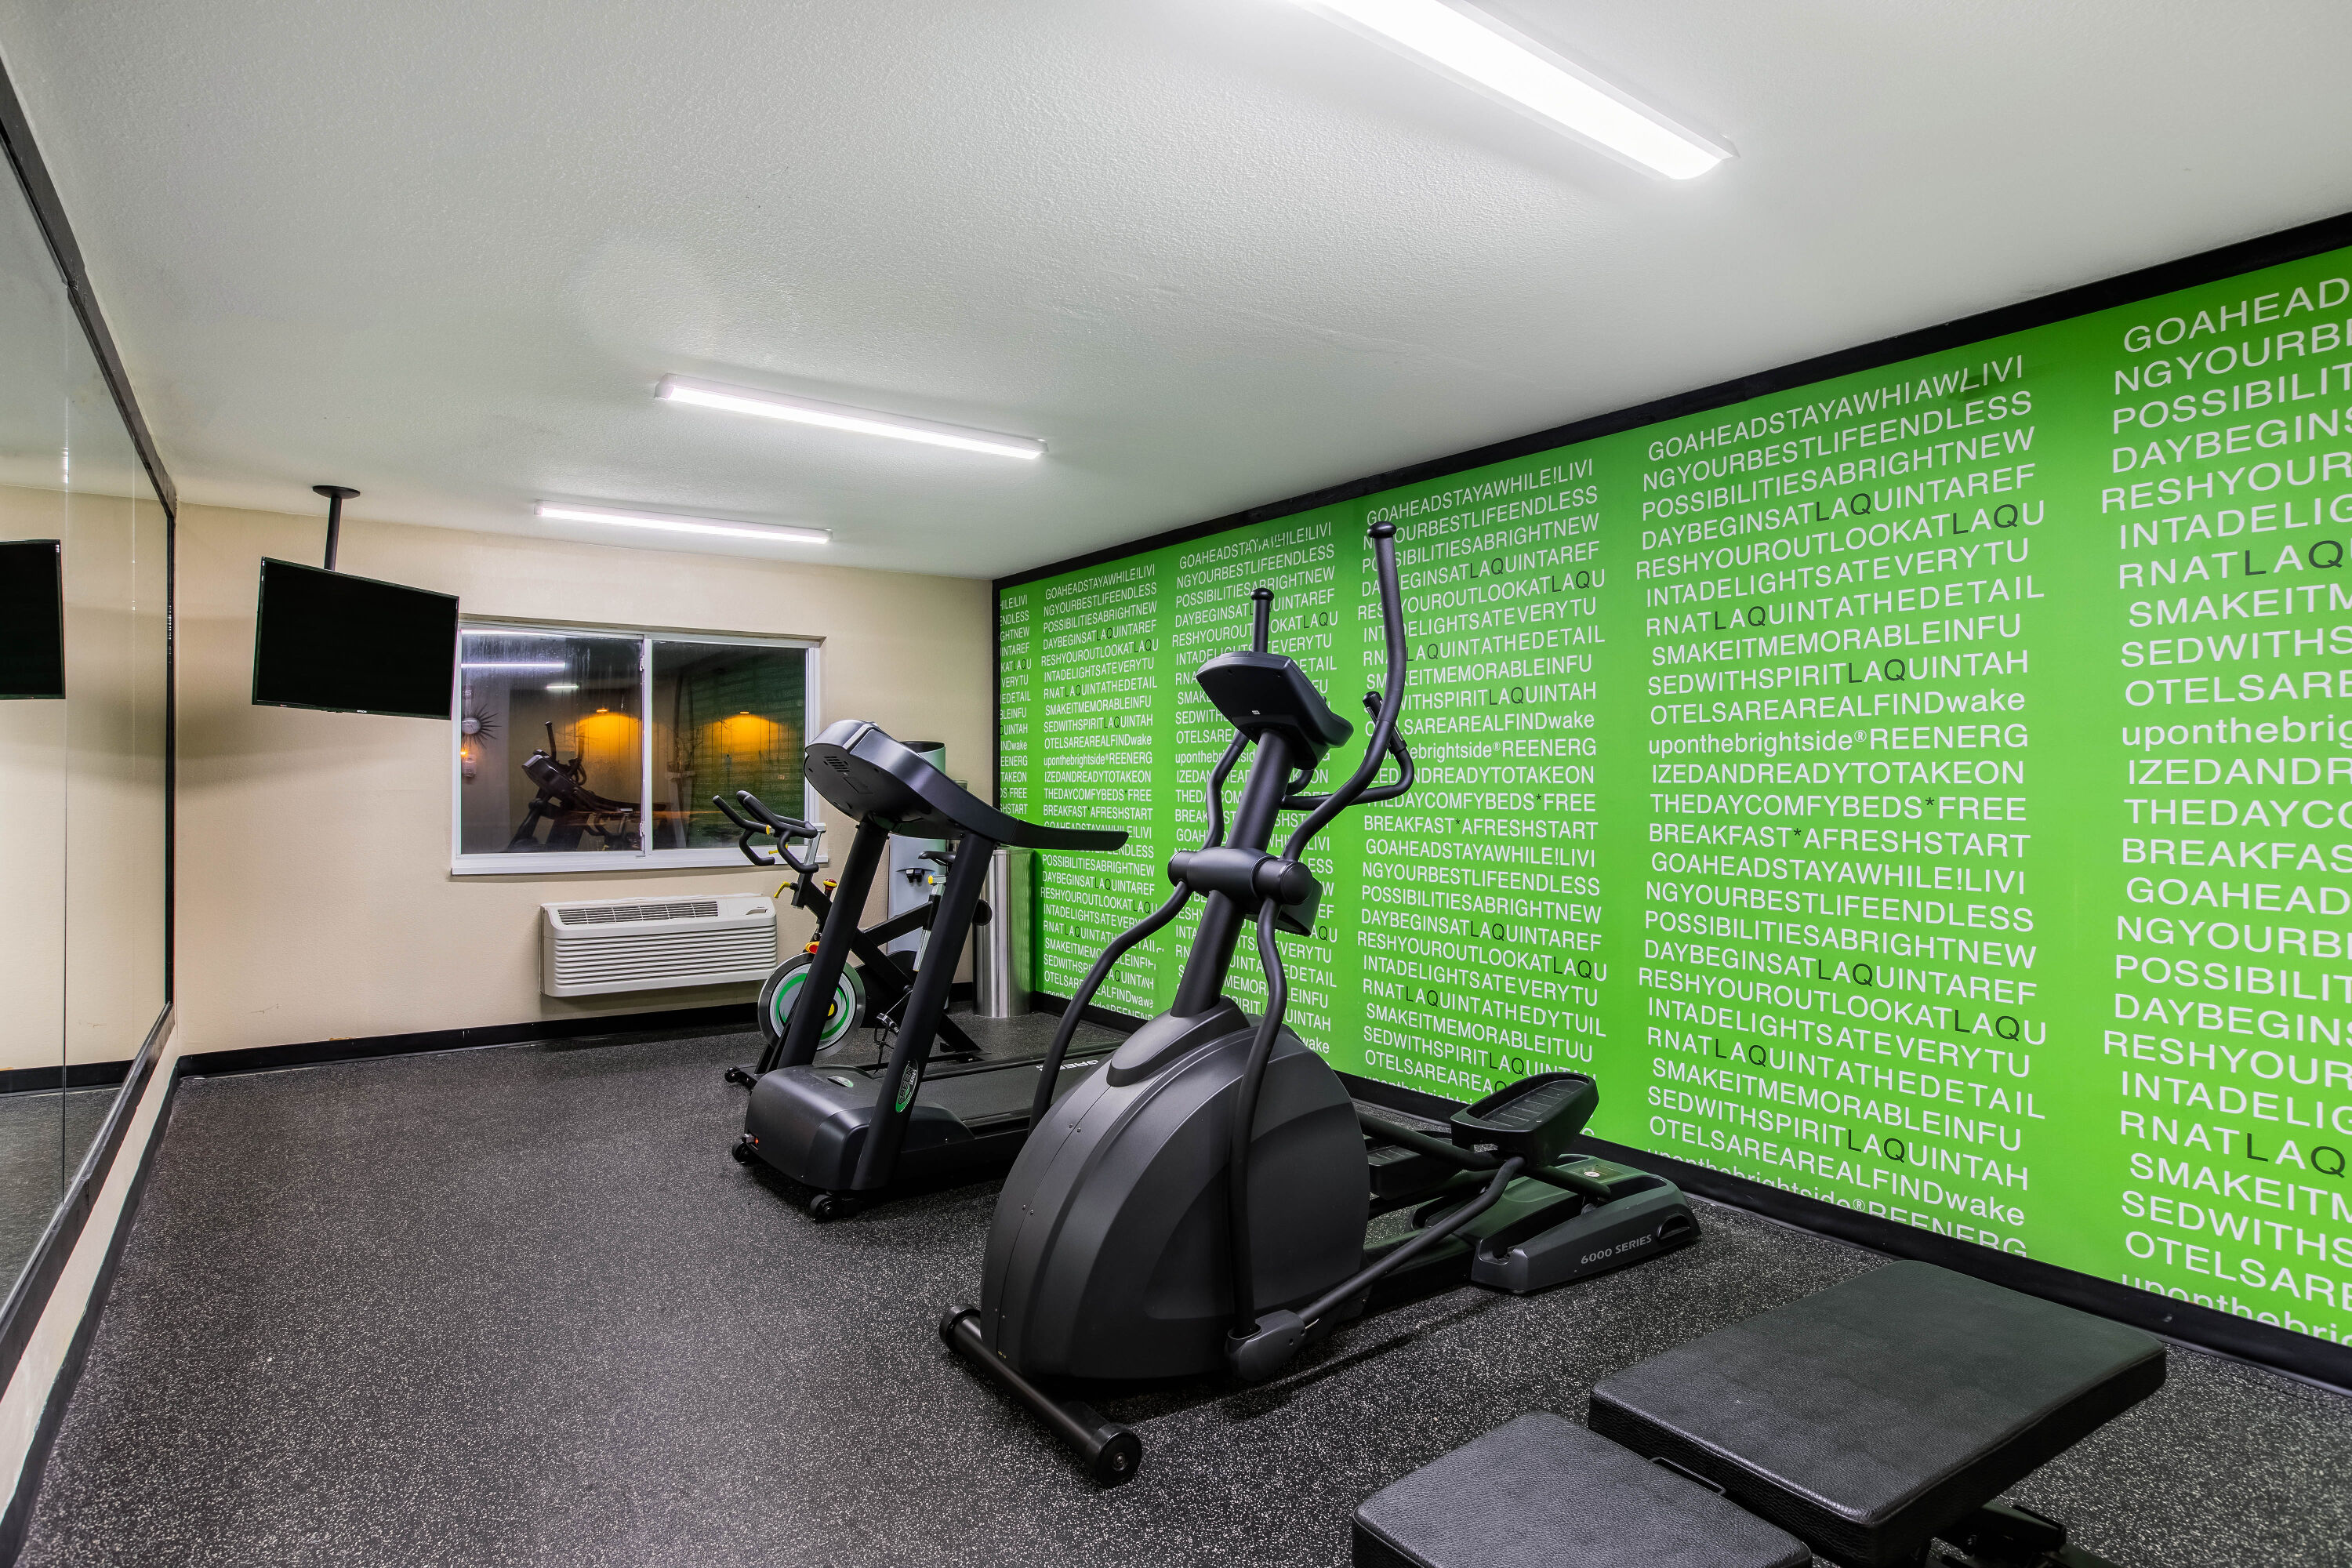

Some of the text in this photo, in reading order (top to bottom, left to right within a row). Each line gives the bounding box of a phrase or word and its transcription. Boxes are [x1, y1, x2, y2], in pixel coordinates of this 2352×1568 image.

[2125, 278, 2349, 352] GOAHEAD
[2115, 319, 2352, 395] NGYOURB
[2114, 362, 2352, 434] POSSIBILIT
[1644, 391, 2031, 492] NGYOURBESTLIFEENDLESS
[1367, 459, 1592, 527] GOAHEADSTAYAWHILE!LIVI
[1643, 426, 2034, 521] POSSIBILITIESABRIGHTNEW
[2102, 452, 2352, 514] RESHYOUR
[1363, 485, 1597, 550] NOURBESTLIFEENDLESS
[2121, 493, 2352, 550] INTADELIG
[1177, 544, 1334, 589] NGYOURBESTLIFEENDLESS
[1363, 513, 1599, 574] PSIBILITIESABRIGHTNEW
[2119, 540, 2352, 590] RNATLAQ
[1046, 564, 1154, 600] GOAHEADSTAYAWHILE!LIVI
[1363, 541, 1599, 597] DAEGINSATLAQUINTAREF
[1647, 537, 2028, 607] INTADELIGHTSATEVERYTU
[1044, 583, 1156, 616] NGYOURBESTLIFEENDLESS
[1044, 601, 1156, 633] POSSIBILITIESABRIGHTNEW
[2129, 583, 2352, 627] SMAKEITM
[1000, 642, 1029, 657] INTAREF
[1653, 613, 2020, 666] SMAKEITMEMORABLEINFU
[2121, 626, 2352, 667] SEDWITHS
[1002, 674, 1028, 688] VERYTU
[1044, 657, 1154, 682] INTADELIGHTSATEVERYTU
[1046, 695, 1151, 716] SMAKEITMEMORABLEINFU
[1651, 688, 2025, 724] OTELSAREAREALFINDwake
[1045, 734, 1152, 749] OTELSAREAREALFINDwake
[1000, 771, 1026, 782] TAKEON
[1045, 770, 1151, 782] IZEDANDREADYTOTAKEON
[1653, 760, 2024, 784] IZEDANDREADYTOTAKEON
[2129, 757, 2352, 785] IZEDANDR
[1043, 855, 1155, 877] POSSIBILITIESABRIGHTNEW
[1367, 839, 1595, 867] GOAHEADSTAYAWHILE!LIVI
[1652, 852, 2024, 895] GOAHEADSTAYAWHILE!LIVI
[2123, 838, 2352, 873] BREAKFAS
[1363, 862, 1599, 896] NGYOURBESTLIFEENDLESS
[2127, 877, 2350, 915] GOAHEAD
[1363, 885, 1602, 924] POSSIBILITIESABRIGHTNEW
[1647, 881, 2034, 932] NGYOURBESTLIFEENDLESS
[1646, 910, 2037, 969] POSSIBILITIESABRIGHTNEW
[2118, 916, 2352, 960] NGYOURB
[1364, 955, 1597, 1007] INTADELIGHTSATEVERYTU
[2116, 954, 2352, 1004] POSSIBILIT
[1650, 997, 2029, 1077] INTADELIGHTSATEVERYTU
[2115, 993, 2352, 1047] DAYBEGIN
[2104, 1030, 2352, 1091] RESHYOUR
[1653, 1058, 2020, 1151] SMAKEITMEMORABLEINFU
[2121, 1110, 2346, 1178] RNATLAQ
[1650, 1116, 2024, 1226] OTELSAREAREALFINDwake
[1581, 1234, 1652, 1264] 6000 SERIES
[2122, 1190, 2352, 1268] SEDWITHS
